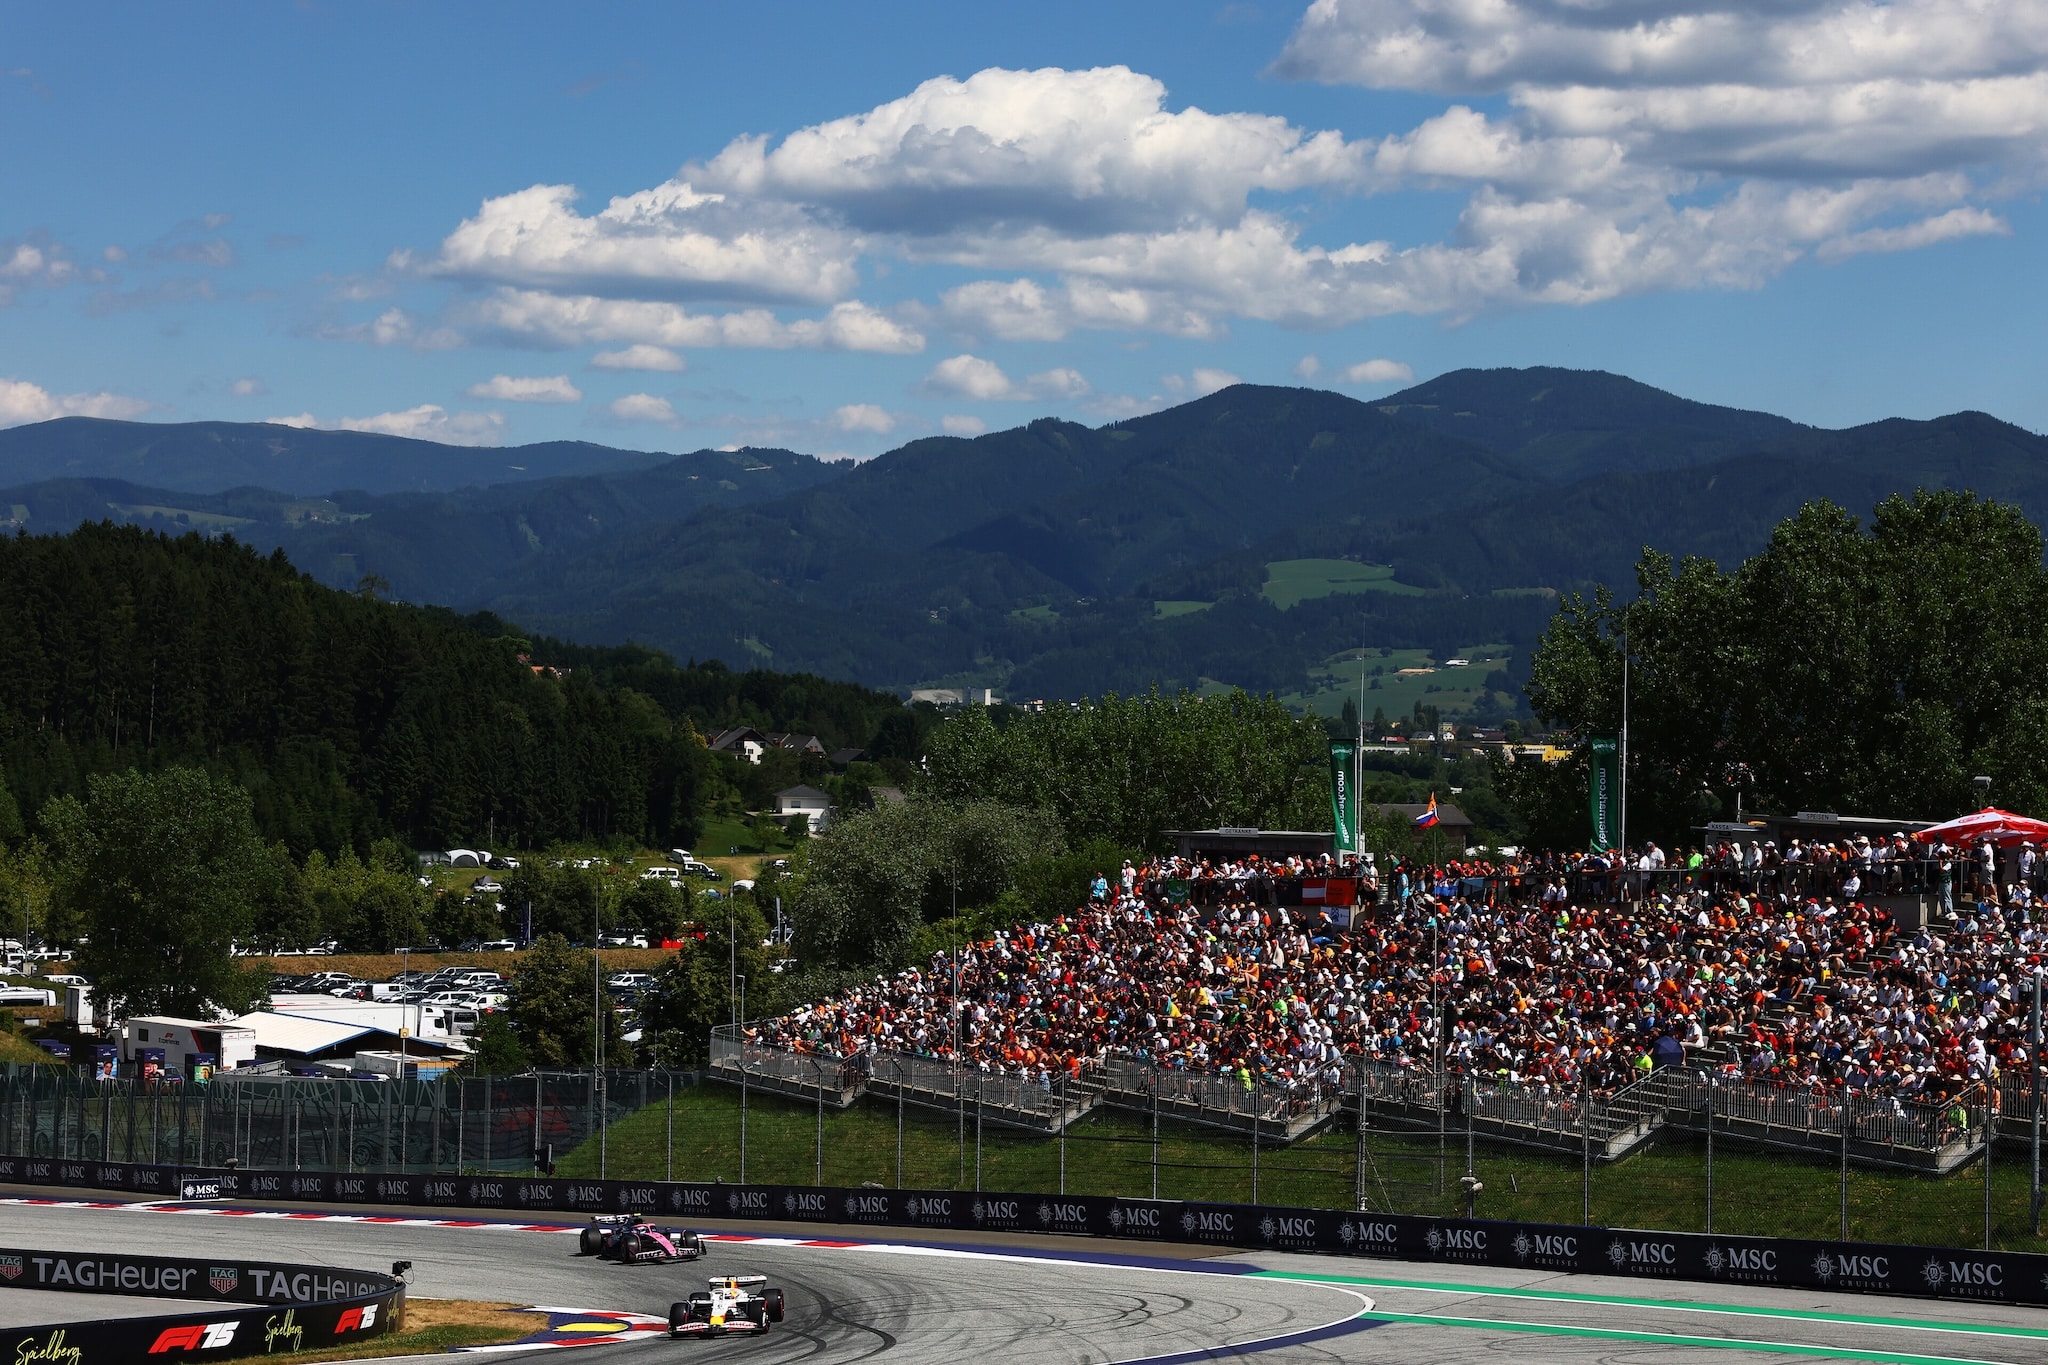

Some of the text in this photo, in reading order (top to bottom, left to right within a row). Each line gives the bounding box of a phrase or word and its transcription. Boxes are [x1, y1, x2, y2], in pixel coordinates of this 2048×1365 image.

[33, 1164, 50, 1176] MSC
[68, 1166, 85, 1178] MSC
[104, 1168, 123, 1181] MSC
[141, 1170, 160, 1185] MSC
[196, 1184, 219, 1194] MSC
[220, 1176, 238, 1189] MSC
[260, 1176, 280, 1191] MSC
[301, 1178, 322, 1192] MSC
[344, 1179, 366, 1194] MSC
[387, 1180, 410, 1196] MSC
[434, 1182, 456, 1197] MSC
[480, 1183, 503, 1198] MSC
[530, 1185, 553, 1200] MSC
[578, 1186, 603, 1202] MSC
[630, 1188, 656, 1204] MSC
[684, 1190, 710, 1206] MSC
[741, 1192, 768, 1208] MSC
[798, 1194, 826, 1211] MSC
[859, 1197, 889, 1213] MSC
[920, 1198, 951, 1216] MSC
[987, 1201, 1018, 1218] MSC
[1054, 1204, 1087, 1222] MSC
[1126, 1208, 1160, 1227] MSC
[1199, 1212, 1234, 1232] MSC
[1278, 1218, 1315, 1237] MSC
[1359, 1222, 1398, 1243] MSC
[1200, 1232, 1235, 1240] CRUISES
[1279, 1238, 1316, 1246] CRUISES
[1446, 1228, 1487, 1250] MSC
[1359, 1244, 1398, 1252] CRUISES
[1534, 1234, 1578, 1257] MSC
[0, 1257, 20, 1265] TAG
[1446, 1251, 1488, 1260] CRUISES
[1630, 1242, 1676, 1265] MSC
[1728, 1248, 1777, 1271] MSC
[1534, 1257, 1578, 1267] CRUISES
[1838, 1254, 1890, 1279] MSC
[213, 1268, 236, 1278] TAG
[1631, 1266, 1677, 1275] CRUISES
[1729, 1272, 1778, 1281] CRUISES
[1949, 1261, 2003, 1286] MSC
[211, 1279, 237, 1292] HEUER
[1840, 1279, 1891, 1289] CRUISES
[1950, 1286, 2004, 1297] CRUISES
[264, 1308, 303, 1352] Spielberg
[15, 1329, 82, 1365] Spielberg
